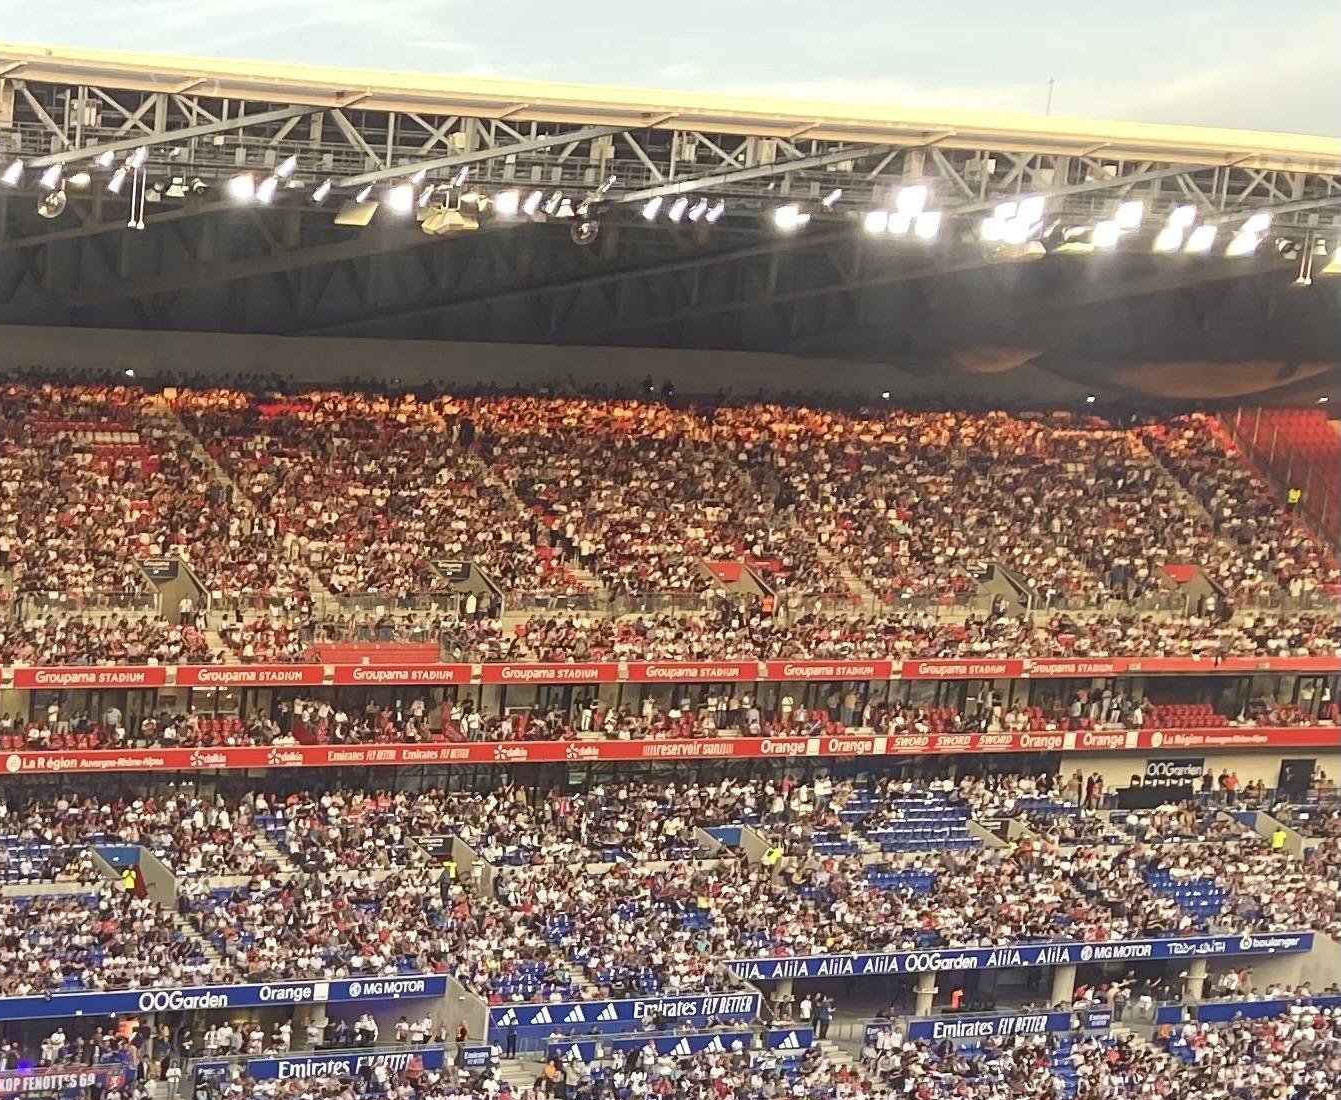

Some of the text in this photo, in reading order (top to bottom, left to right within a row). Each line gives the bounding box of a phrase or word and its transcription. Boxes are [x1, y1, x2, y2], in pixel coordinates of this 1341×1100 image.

[198, 669, 303, 683] Groupama STADIUM
[353, 667, 454, 682] Groupama STADIUM
[501, 666, 598, 680] Groupama STADIUM
[646, 665, 740, 678] Groupama STADIUM
[784, 664, 875, 677] Groupama STADIUM
[919, 662, 1006, 676] Groupama STADIUM
[35, 670, 145, 685] Groupama STADIUM
[761, 740, 805, 755] Orange
[828, 739, 872, 753] Orange
[1020, 734, 1062, 749] Orange
[1083, 733, 1124, 747] Orange
[22, 758, 36, 769] La
[37, 756, 78, 771] Région
[1094, 947, 1111, 959] MG
[1112, 944, 1151, 957] MOTOR
[905, 952, 977, 971] OOGarden
[259, 986, 311, 1002] Orange
[363, 983, 382, 995] MG
[383, 980, 425, 994] MOTOR
[139, 990, 228, 1012] OOGarden
[634, 1000, 697, 1019] Emirates
[933, 1020, 993, 1039] Emirates
[278, 1059, 350, 1079] Emirates
[80, 1073, 96, 1086] 69
